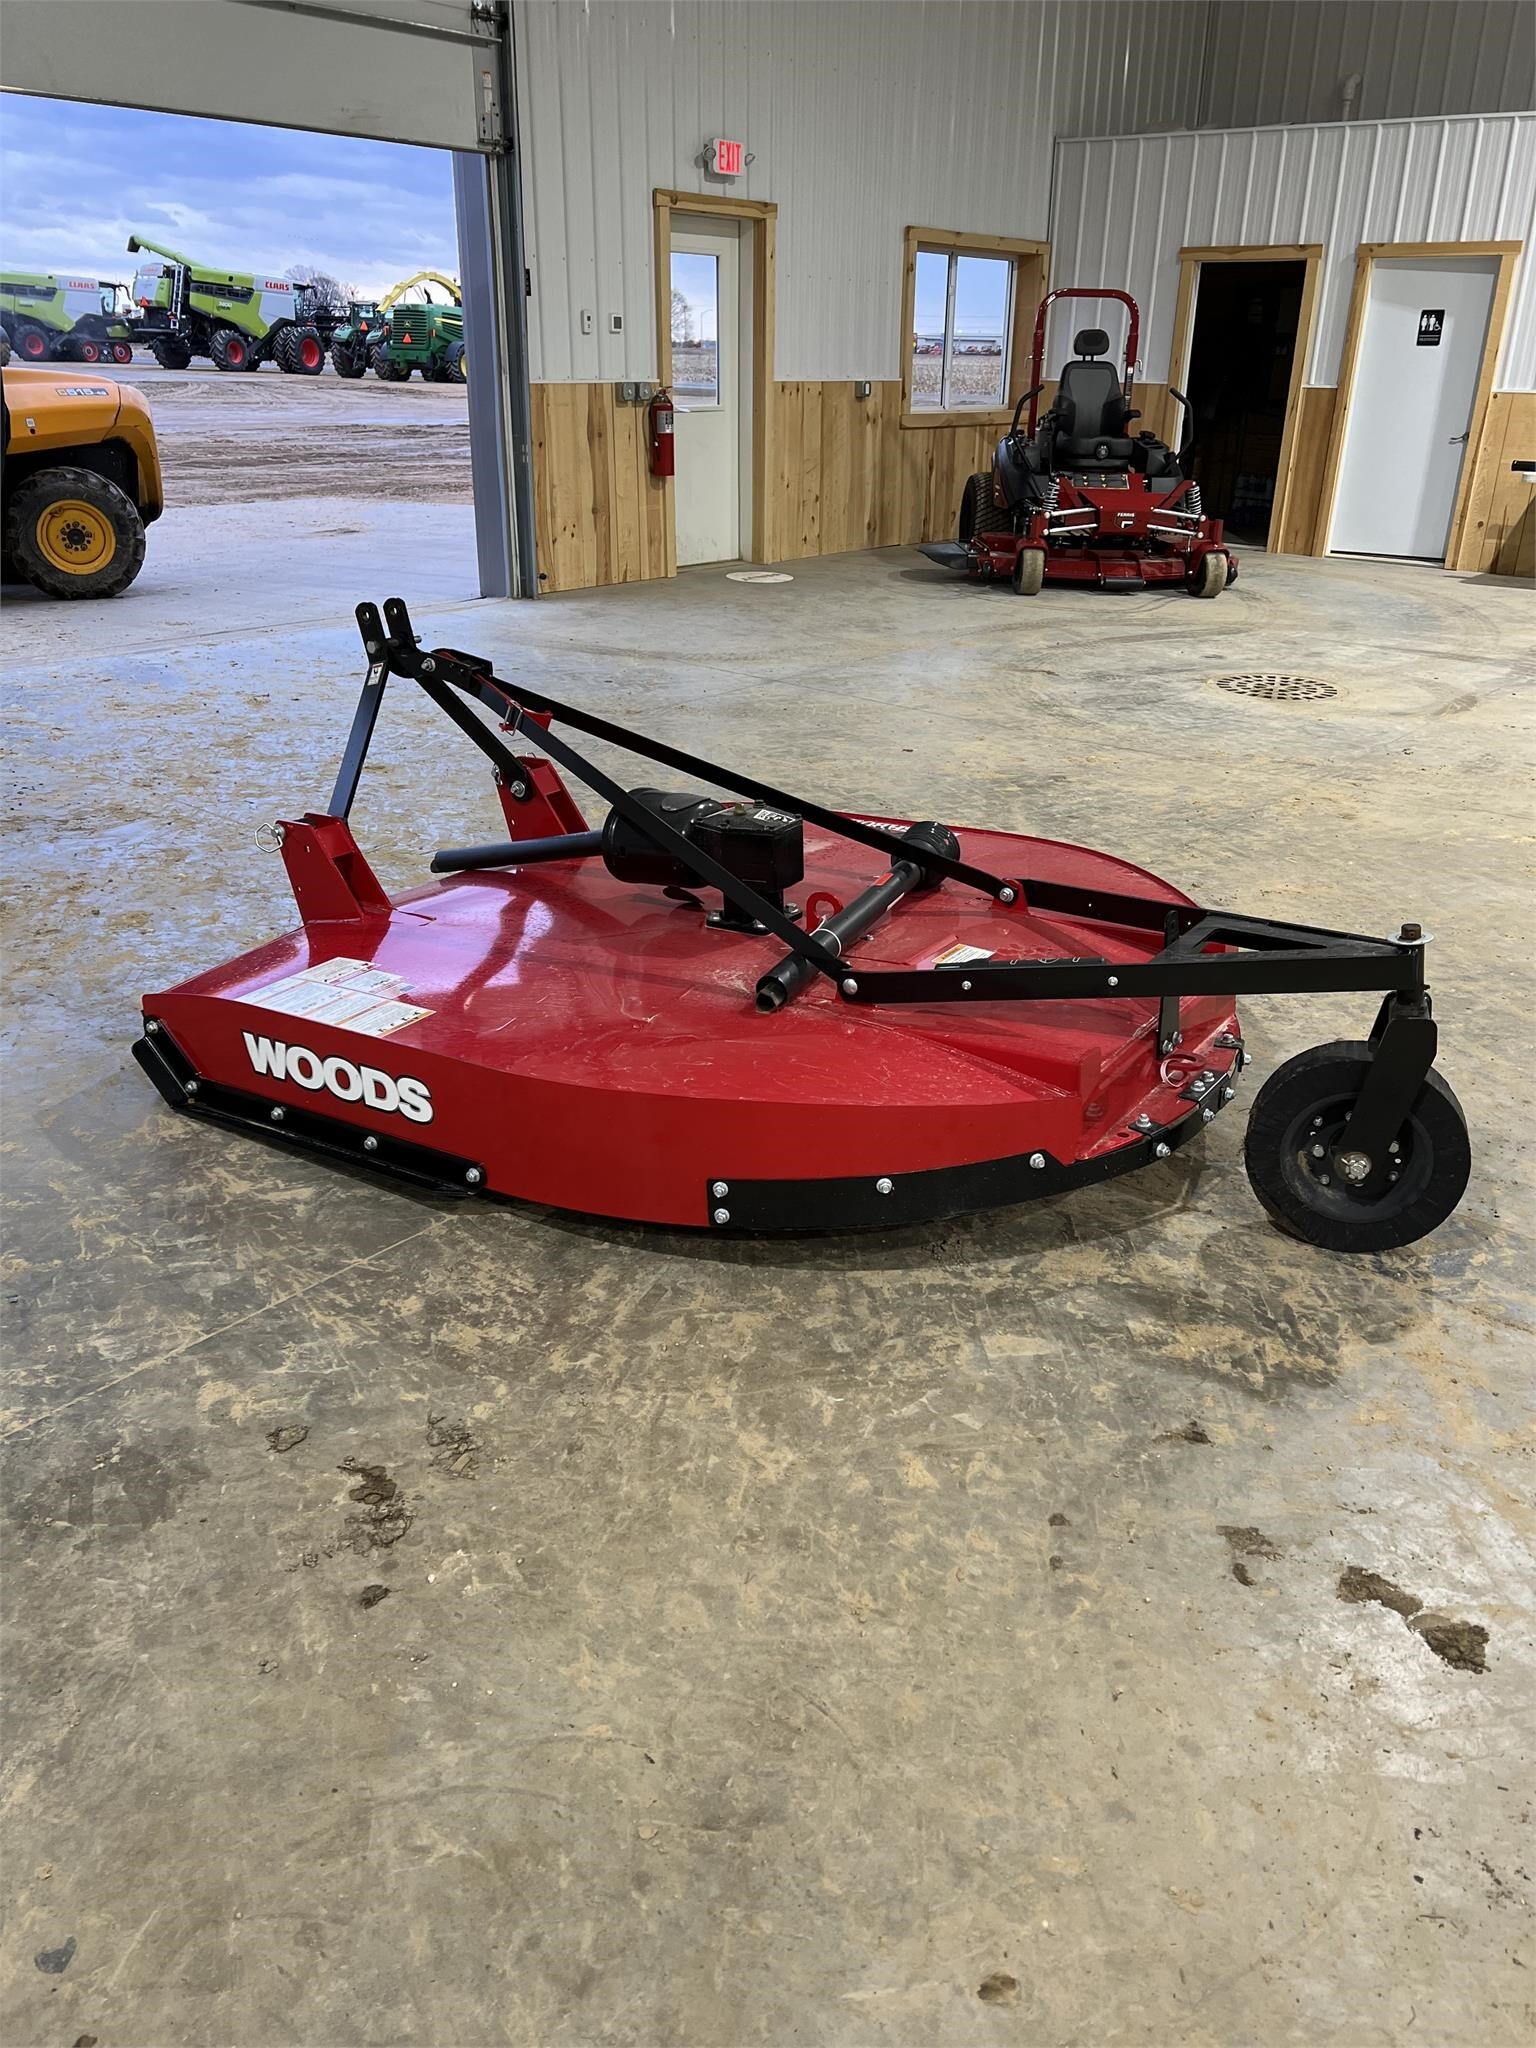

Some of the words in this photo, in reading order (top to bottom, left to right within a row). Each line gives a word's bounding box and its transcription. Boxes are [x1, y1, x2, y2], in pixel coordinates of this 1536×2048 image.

[719, 140, 742, 173] EXIT
[265, 281, 290, 291] CLAAS
[242, 1031, 434, 1123] WOODS
